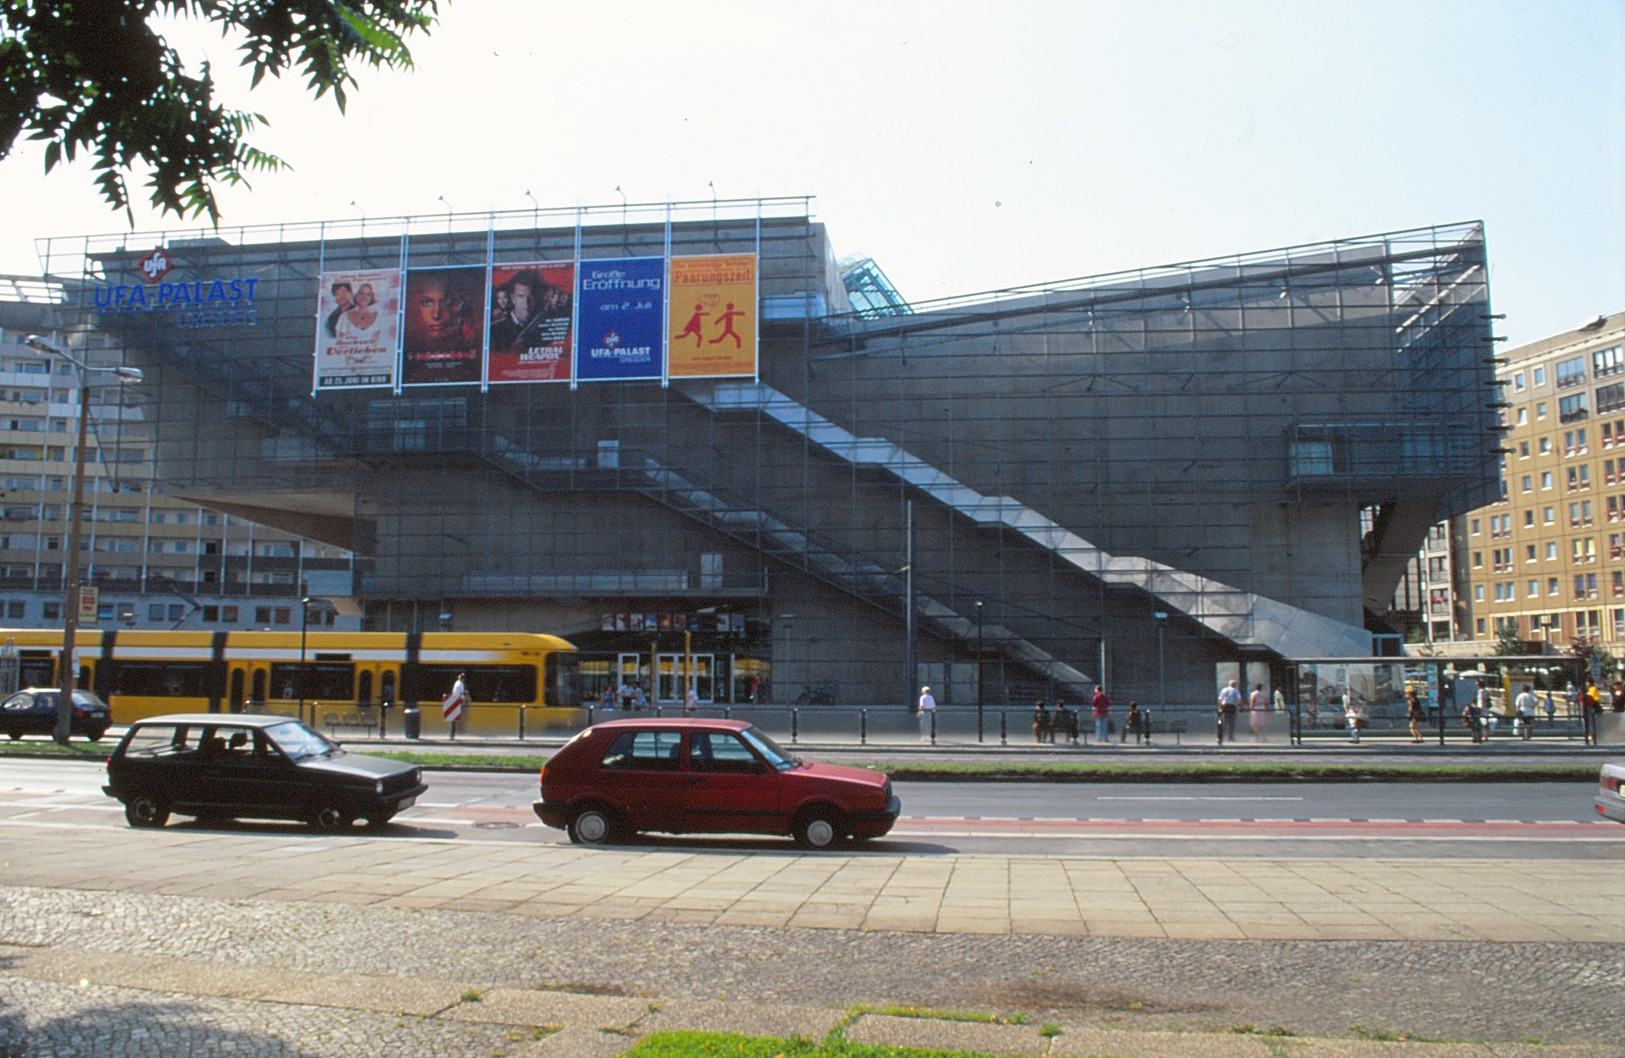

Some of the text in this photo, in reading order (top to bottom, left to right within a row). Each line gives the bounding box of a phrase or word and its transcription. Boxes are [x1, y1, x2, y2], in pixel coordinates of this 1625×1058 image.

[582, 278, 661, 290] Eröffnung
[675, 270, 752, 285] Paarungszeit
[93, 278, 259, 309] UFA-PALAST
[600, 303, 619, 311] am
[178, 309, 258, 328] DRESDEN
[326, 346, 387, 356] Verlieben
